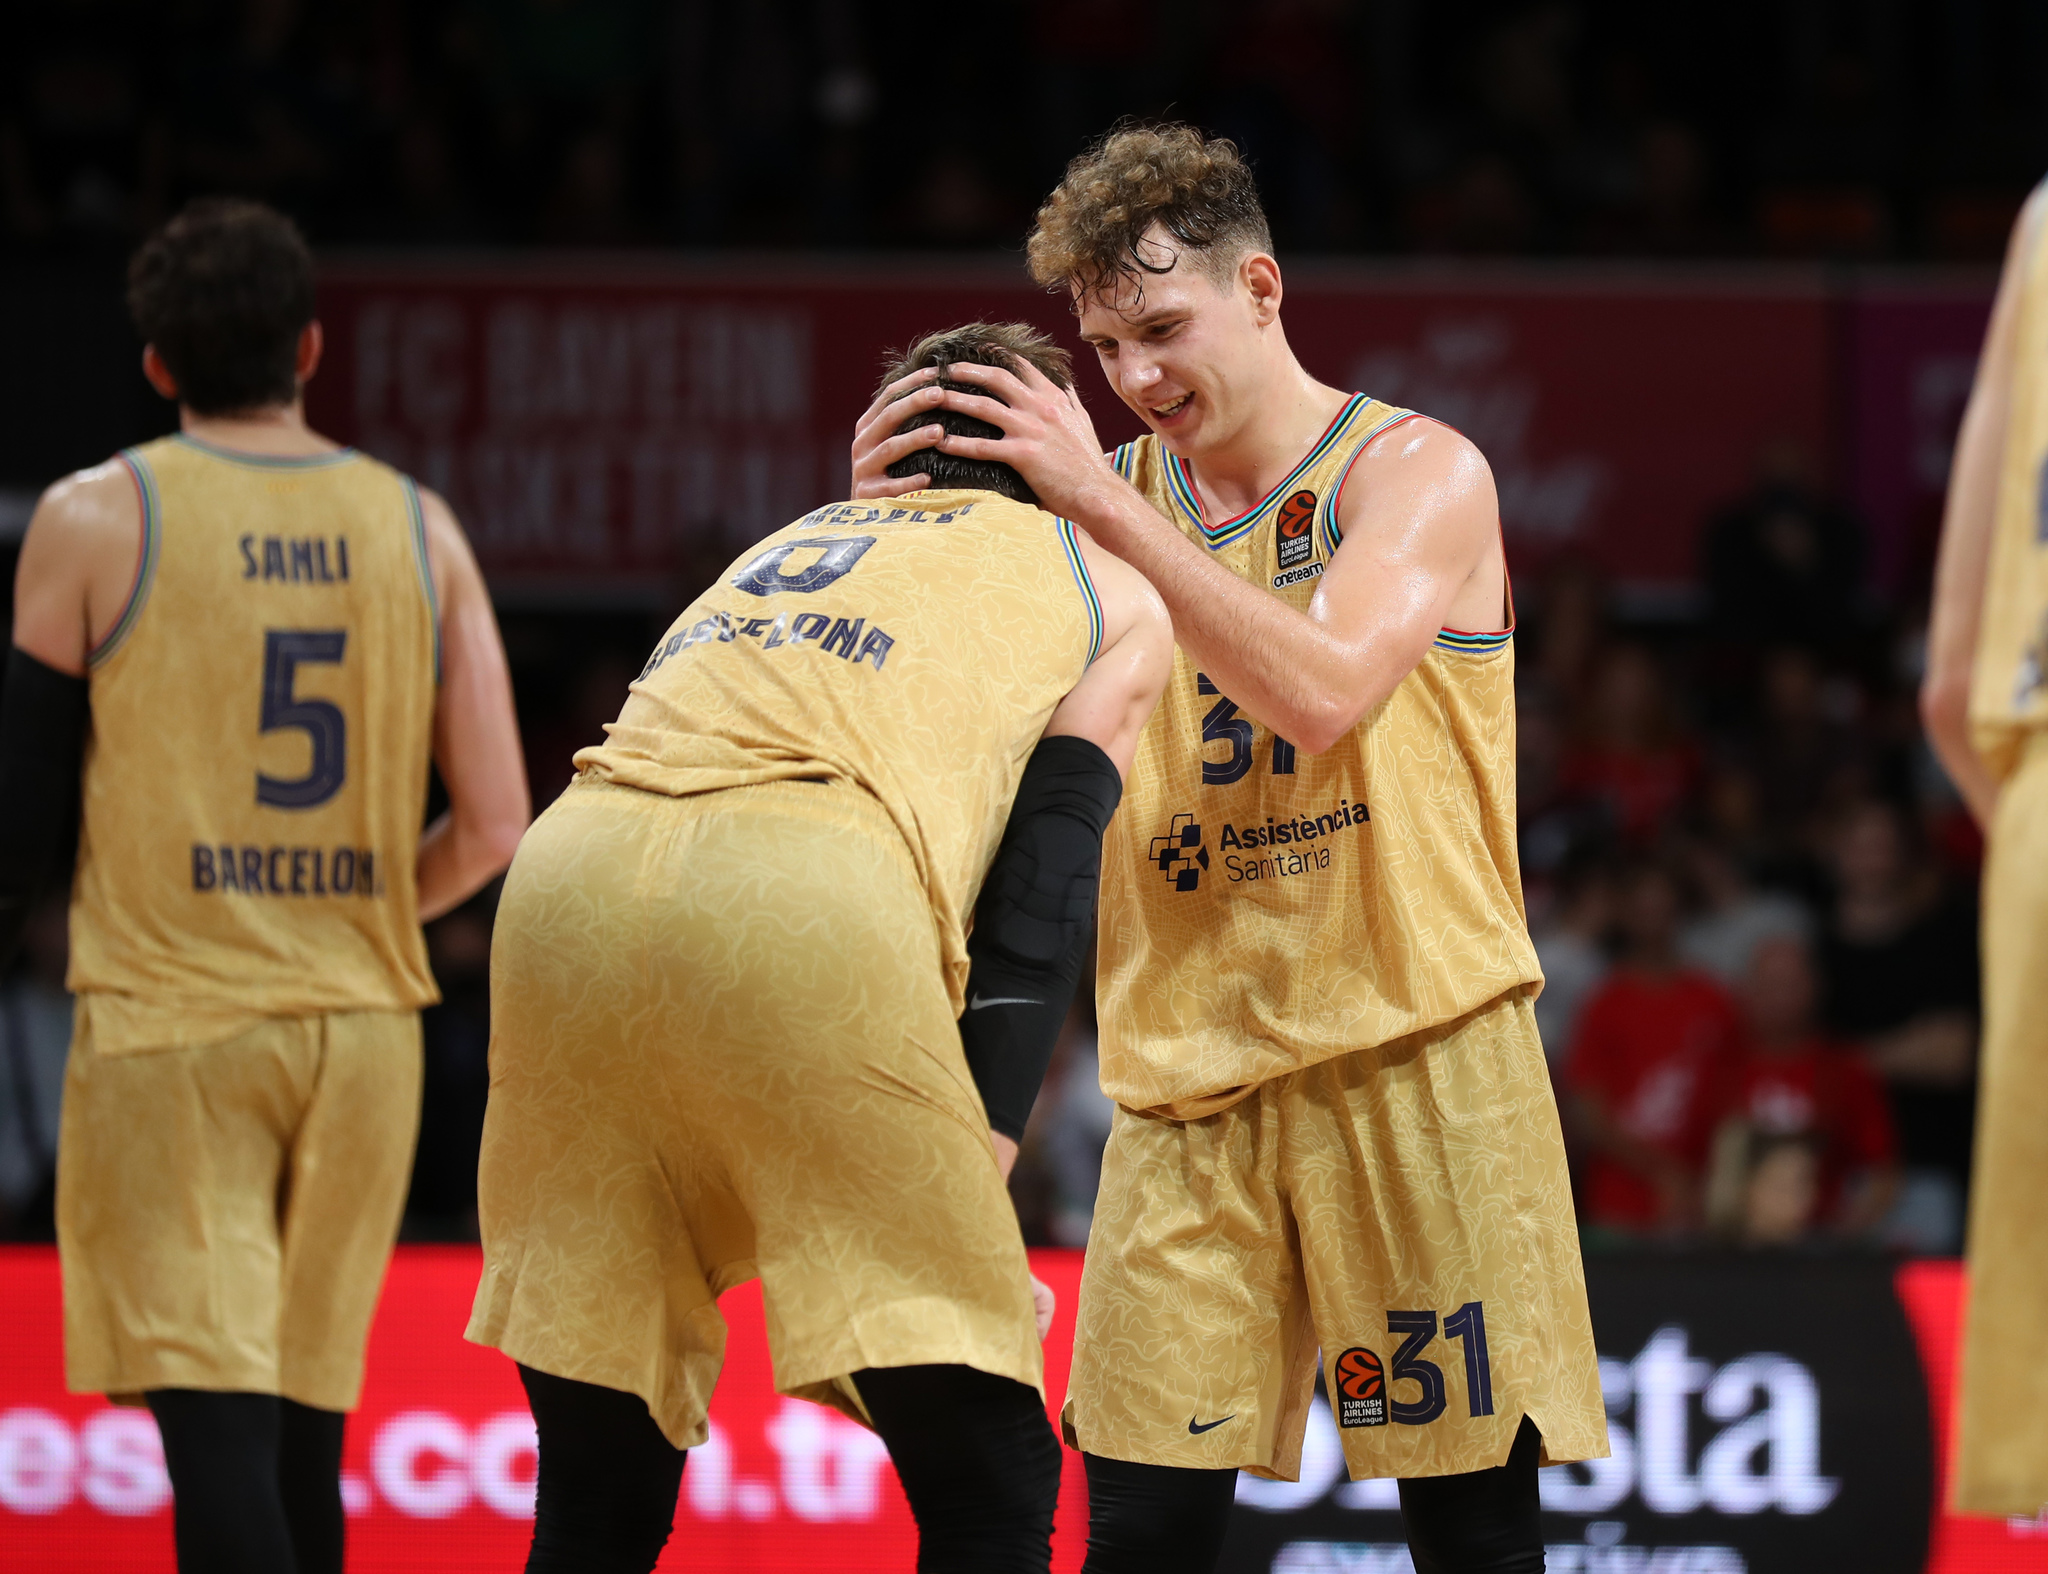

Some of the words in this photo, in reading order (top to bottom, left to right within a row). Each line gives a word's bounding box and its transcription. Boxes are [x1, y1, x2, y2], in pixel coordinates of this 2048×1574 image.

[1280, 535, 1309, 550] TURKISH
[1280, 542, 1309, 558] AIRLINES
[1280, 551, 1309, 566] EuroLeague
[1273, 562, 1324, 588] oneteam
[255, 627, 350, 812] 5
[1219, 799, 1371, 852] Assistència
[1225, 844, 1330, 882] Sanitària
[1386, 1301, 1495, 1425] 31
[1343, 1399, 1382, 1410] TURKISH
[1343, 1407, 1383, 1418] AIRLINES
[1343, 1416, 1384, 1425] EuroLeague
